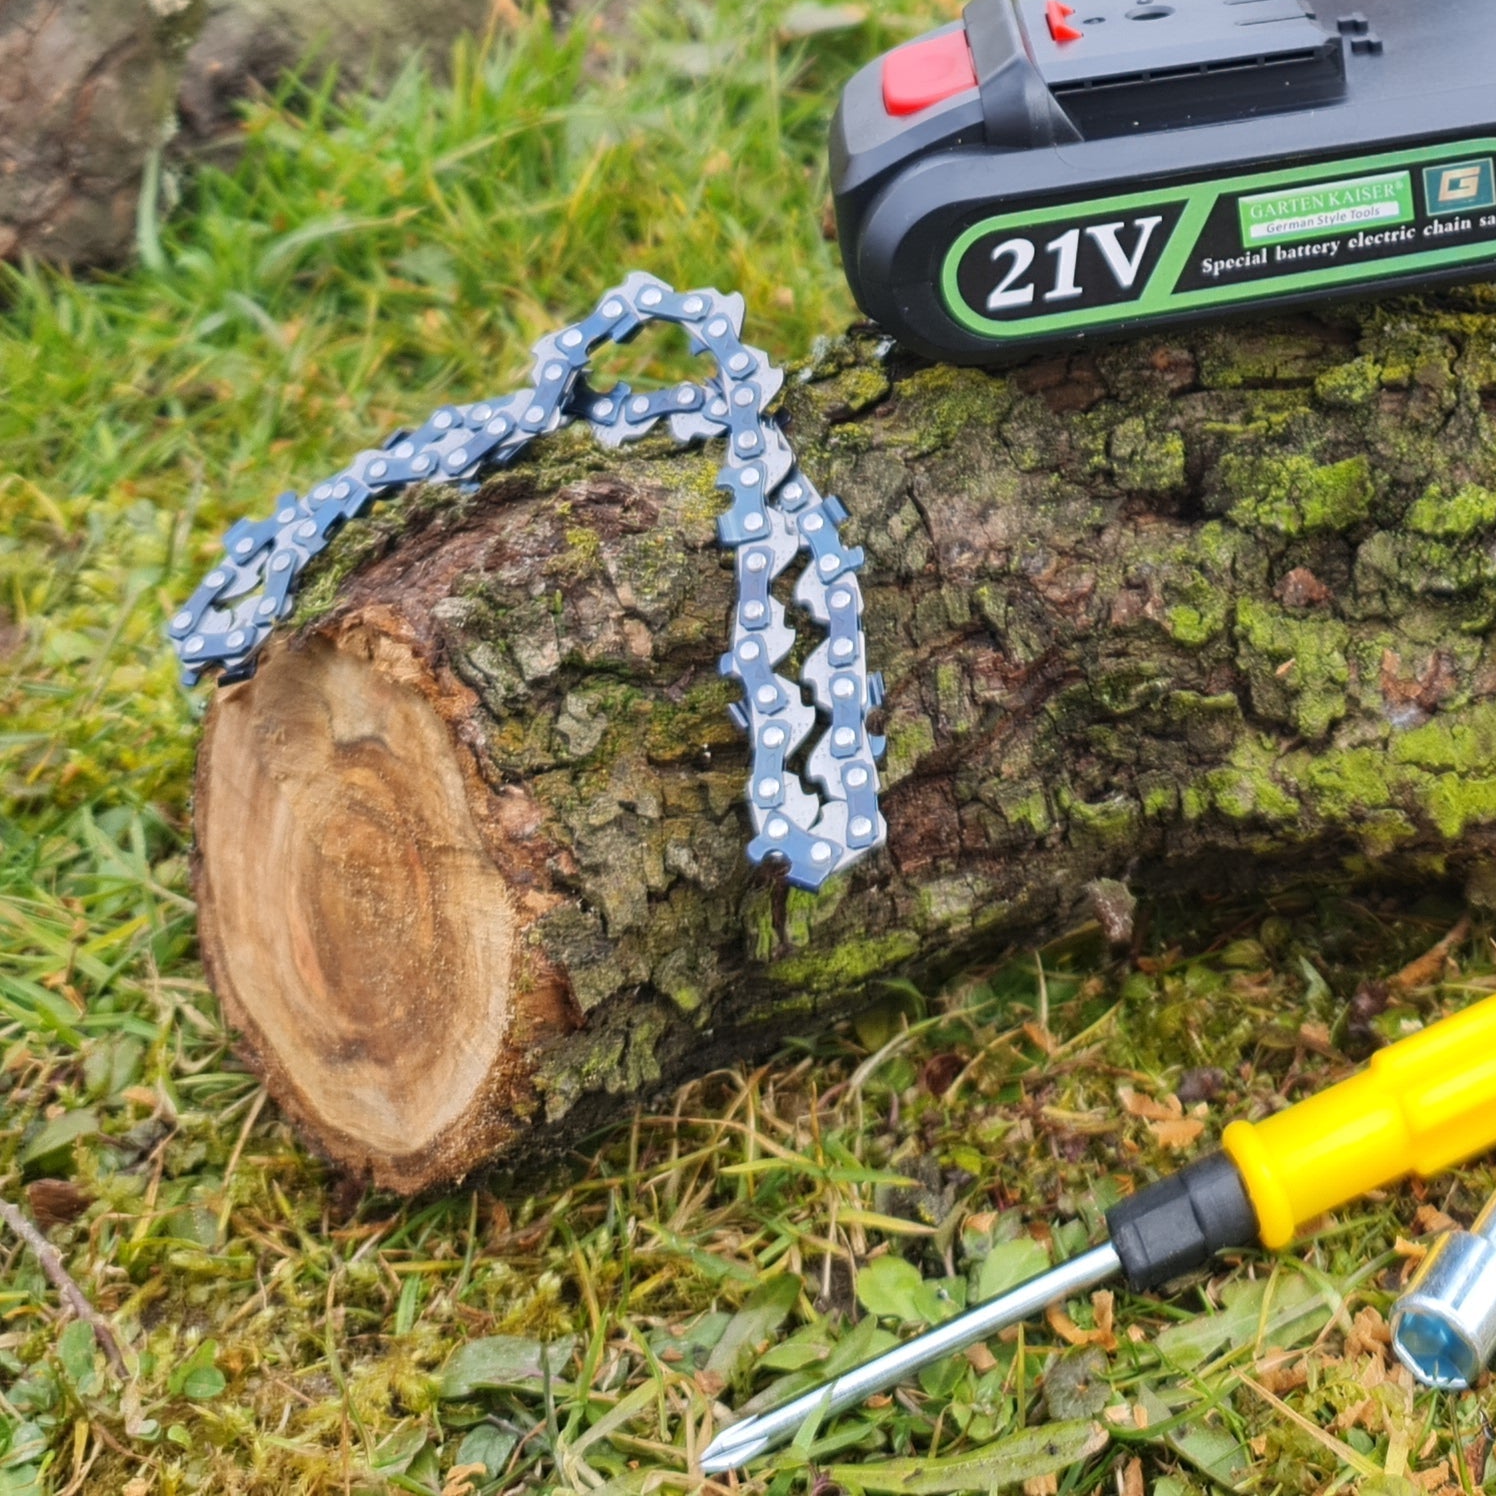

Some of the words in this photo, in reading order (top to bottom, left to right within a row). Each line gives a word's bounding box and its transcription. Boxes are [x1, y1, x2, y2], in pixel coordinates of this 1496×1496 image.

[1250, 194, 1325, 218] GARTEN
[1266, 219, 1314, 234] German
[1317, 212, 1347, 226] Style
[1350, 205, 1380, 220] Tools
[987, 215, 1163, 311] 21V
[1201, 245, 1269, 277] Special
[1275, 237, 1340, 262] battery
[1347, 227, 1416, 250] electric
[1422, 215, 1472, 237] chain
